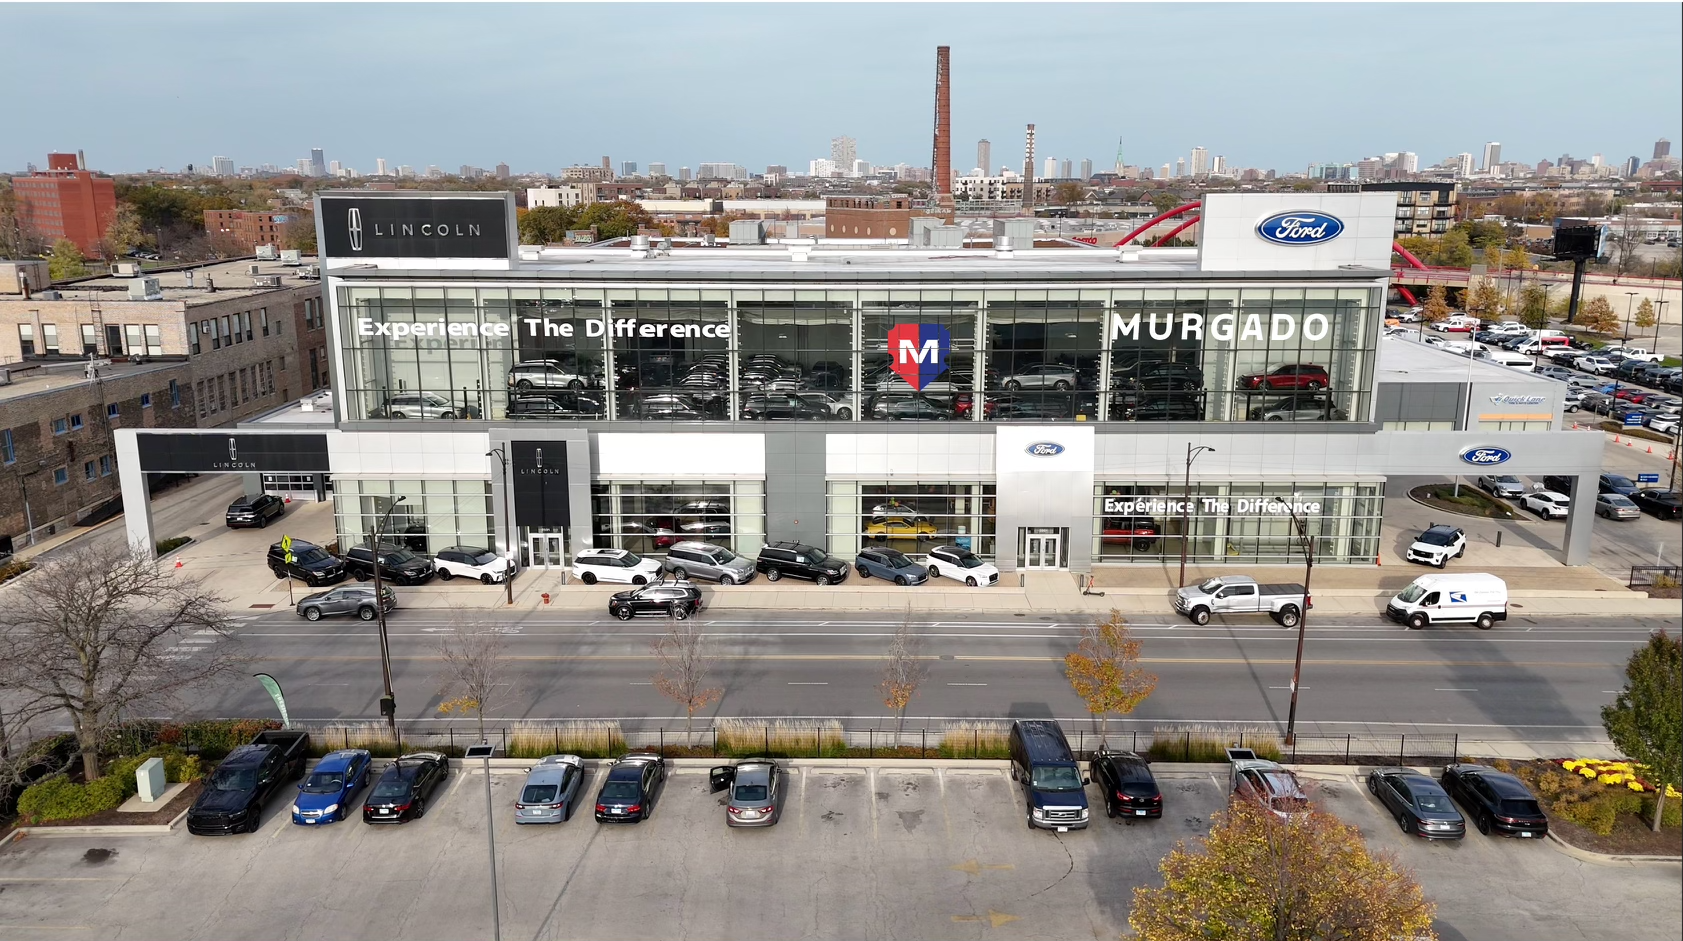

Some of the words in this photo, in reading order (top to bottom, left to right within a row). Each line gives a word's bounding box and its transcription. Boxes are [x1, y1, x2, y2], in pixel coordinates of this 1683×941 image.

[374, 223, 481, 236] LINCOLN
[1275, 217, 1328, 238] Ford
[357, 318, 510, 341] Experience
[524, 318, 573, 337] The
[585, 318, 731, 338] Difference
[1111, 313, 1329, 341] MURGADO
[899, 339, 938, 364] M
[1033, 444, 1058, 455] Ford
[1472, 450, 1501, 462] Ford
[1104, 498, 1194, 515] Experience
[1202, 498, 1229, 513] The
[1237, 498, 1320, 513] Difference
